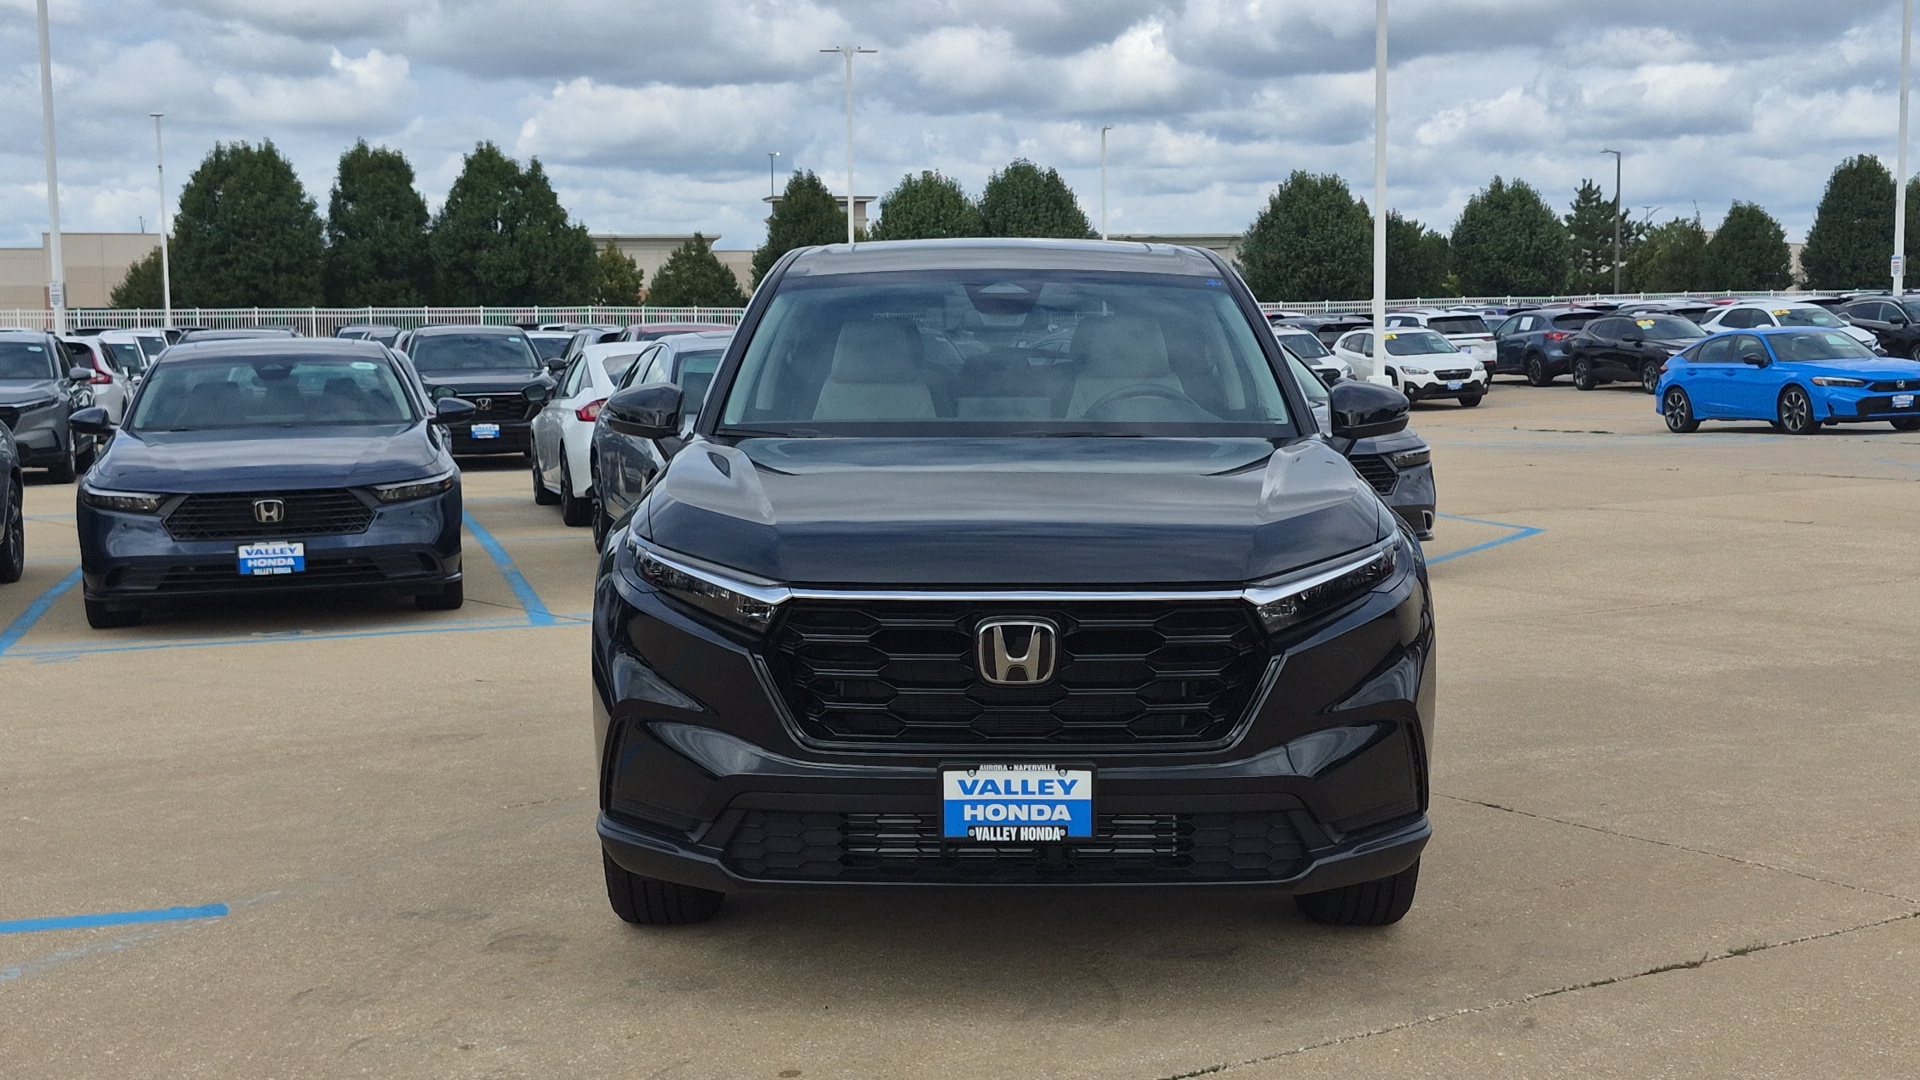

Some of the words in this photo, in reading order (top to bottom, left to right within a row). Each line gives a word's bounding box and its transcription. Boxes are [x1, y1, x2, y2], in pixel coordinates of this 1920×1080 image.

[245, 547, 297, 556] VALLEY
[247, 557, 296, 567] HONDA
[957, 779, 1078, 796] VALLEY
[964, 803, 1072, 821] HONDA
[975, 826, 1018, 841] VALLEY
[1020, 826, 1061, 841] HONDA
